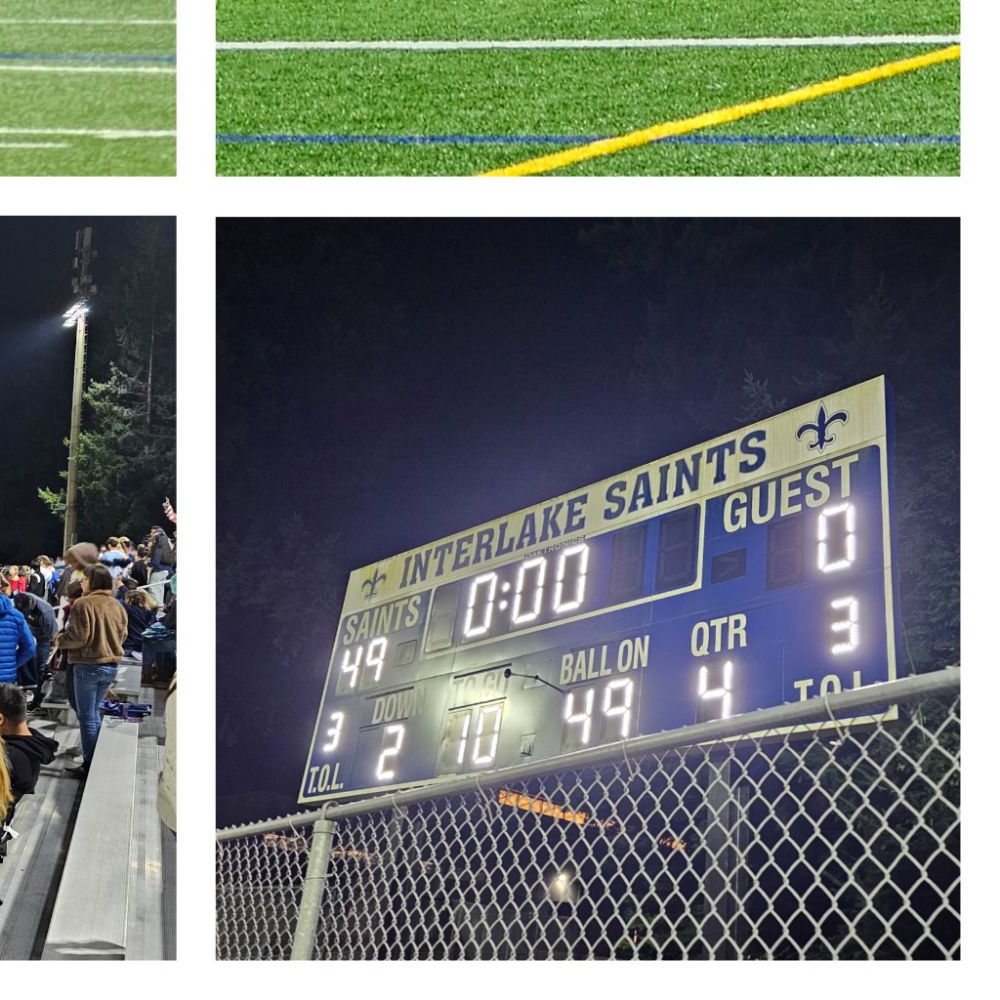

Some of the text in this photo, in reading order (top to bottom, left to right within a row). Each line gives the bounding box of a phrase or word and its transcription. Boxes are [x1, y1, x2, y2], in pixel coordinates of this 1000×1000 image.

[399, 429, 767, 590] INTERLAKE SAINTS
[723, 453, 860, 533] GUEST
[818, 501, 856, 573] 0
[463, 542, 590, 638] 0:00
[342, 595, 422, 646] SAINTS
[691, 613, 748, 657] QTR
[830, 596, 859, 656] 3
[341, 636, 388, 689] 49
[559, 635, 650, 685] BALL ON
[371, 686, 427, 725] DOWN
[565, 678, 633, 744] 49
[698, 660, 734, 720] 4
[322, 711, 344, 753] 3
[376, 723, 405, 781] 2
[457, 706, 502, 764] 10
[307, 762, 344, 794] T.O.L.
